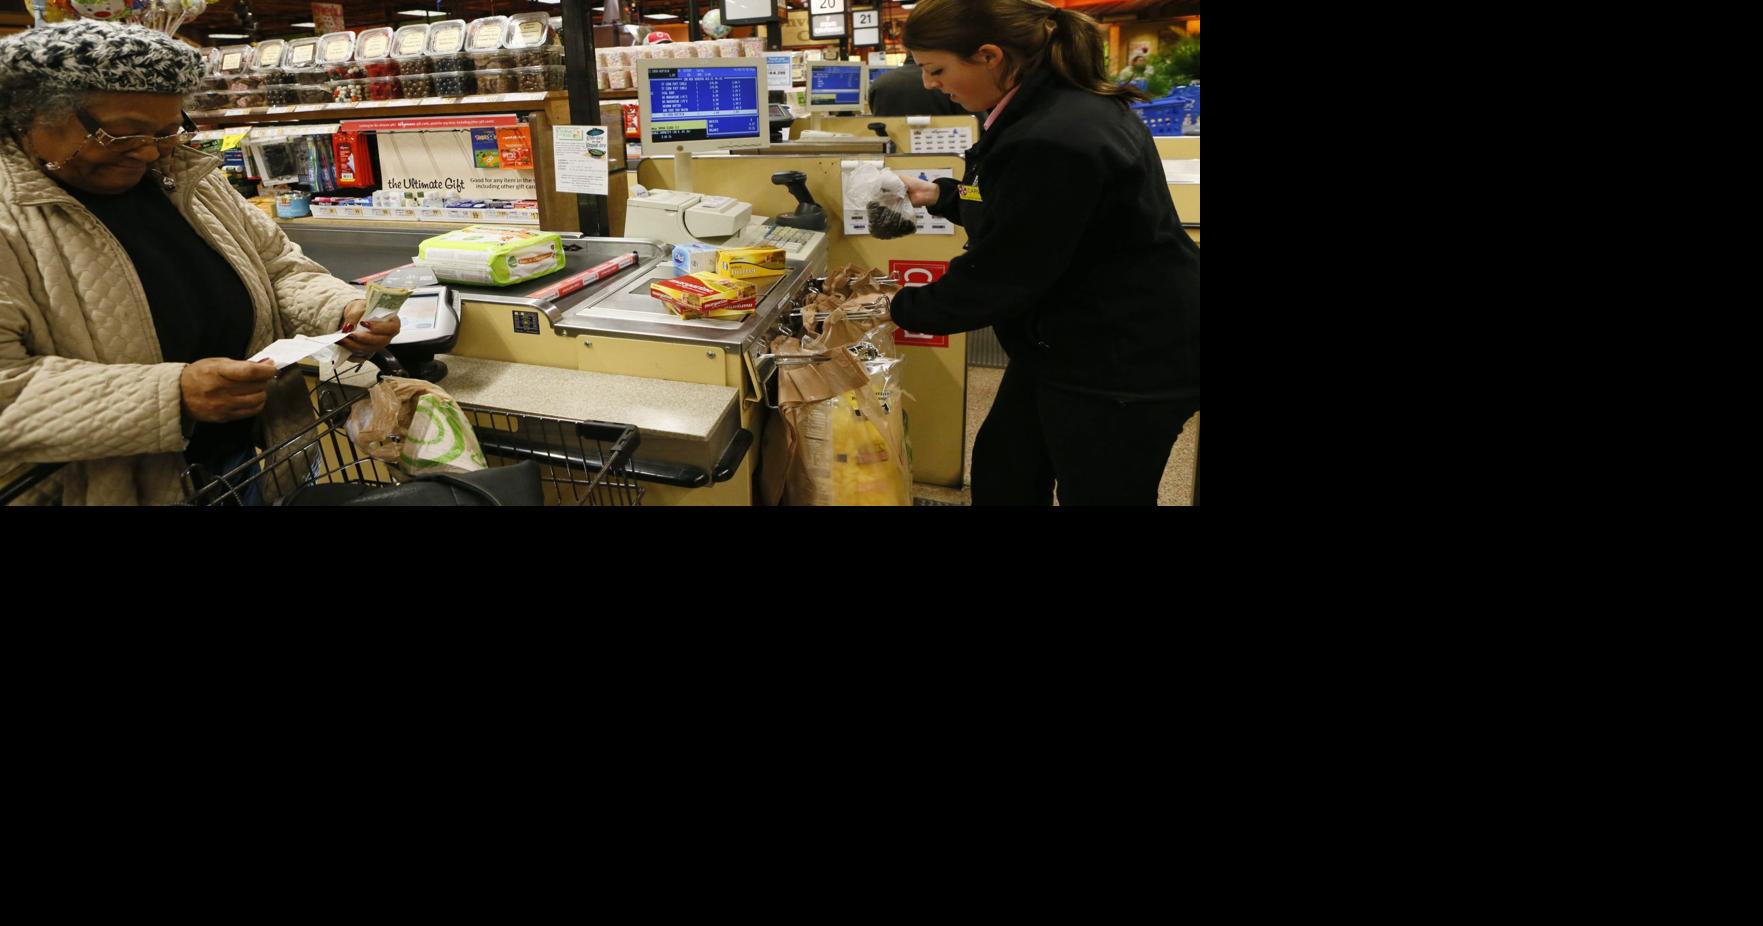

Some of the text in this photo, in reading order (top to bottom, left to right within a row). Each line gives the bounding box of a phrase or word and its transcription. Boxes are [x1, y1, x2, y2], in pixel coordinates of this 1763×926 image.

[819, 0, 836, 9] 20
[859, 14, 872, 24] 21
[387, 177, 465, 193] the Ultimate Gift
[515, 183, 525, 191] gift
